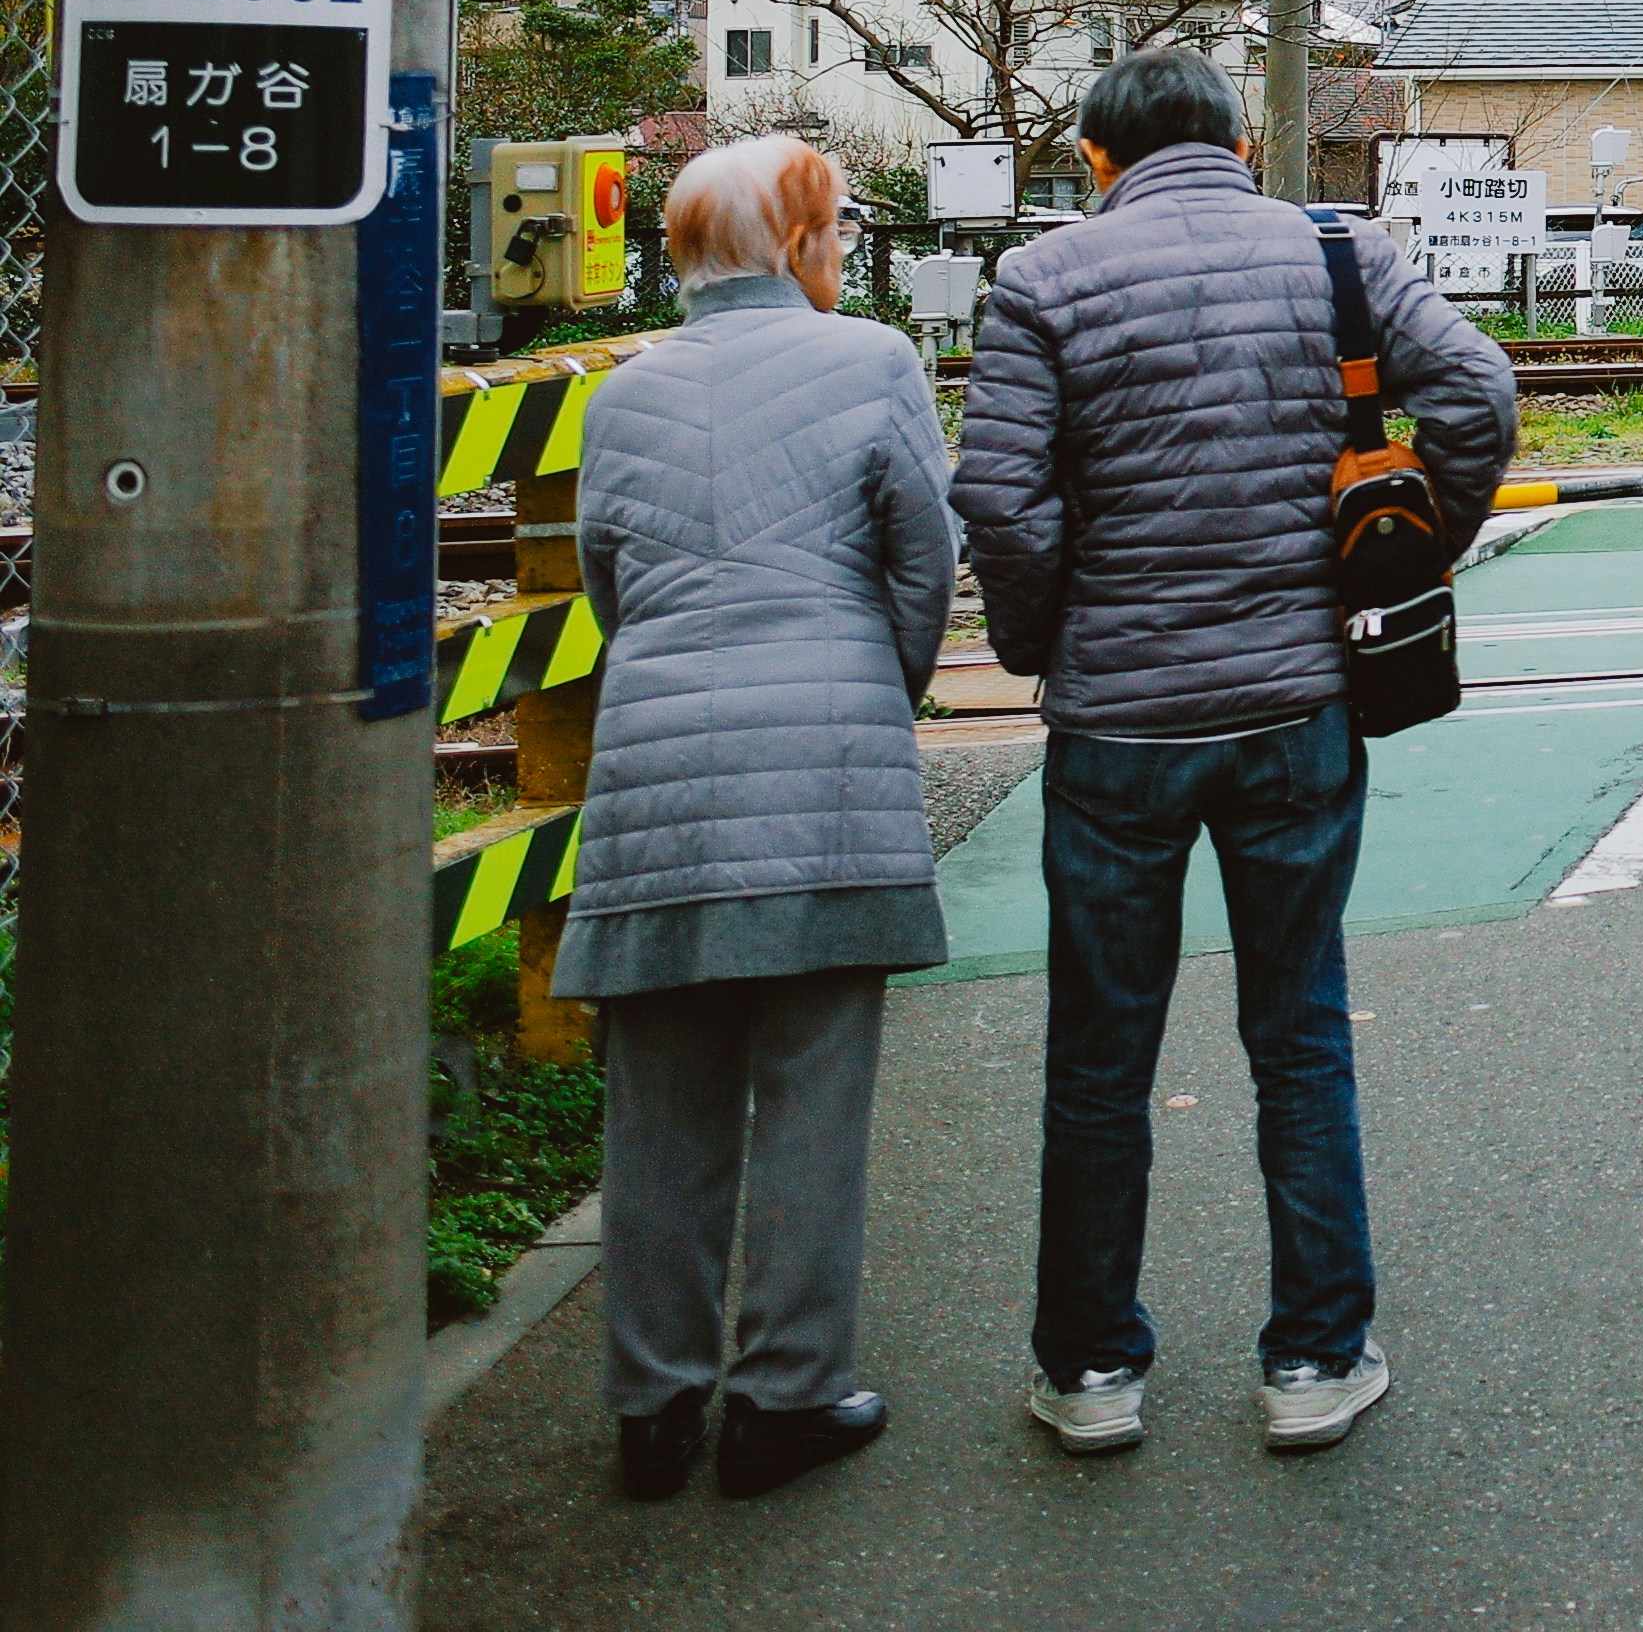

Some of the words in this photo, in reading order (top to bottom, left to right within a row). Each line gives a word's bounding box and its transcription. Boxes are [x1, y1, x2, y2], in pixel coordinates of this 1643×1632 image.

[124, 57, 311, 110] 扇ガ谷
[150, 124, 279, 172] 1-8
[1439, 177, 1528, 199] 小町踏切
[1446, 210, 1524, 223] 4K315M
